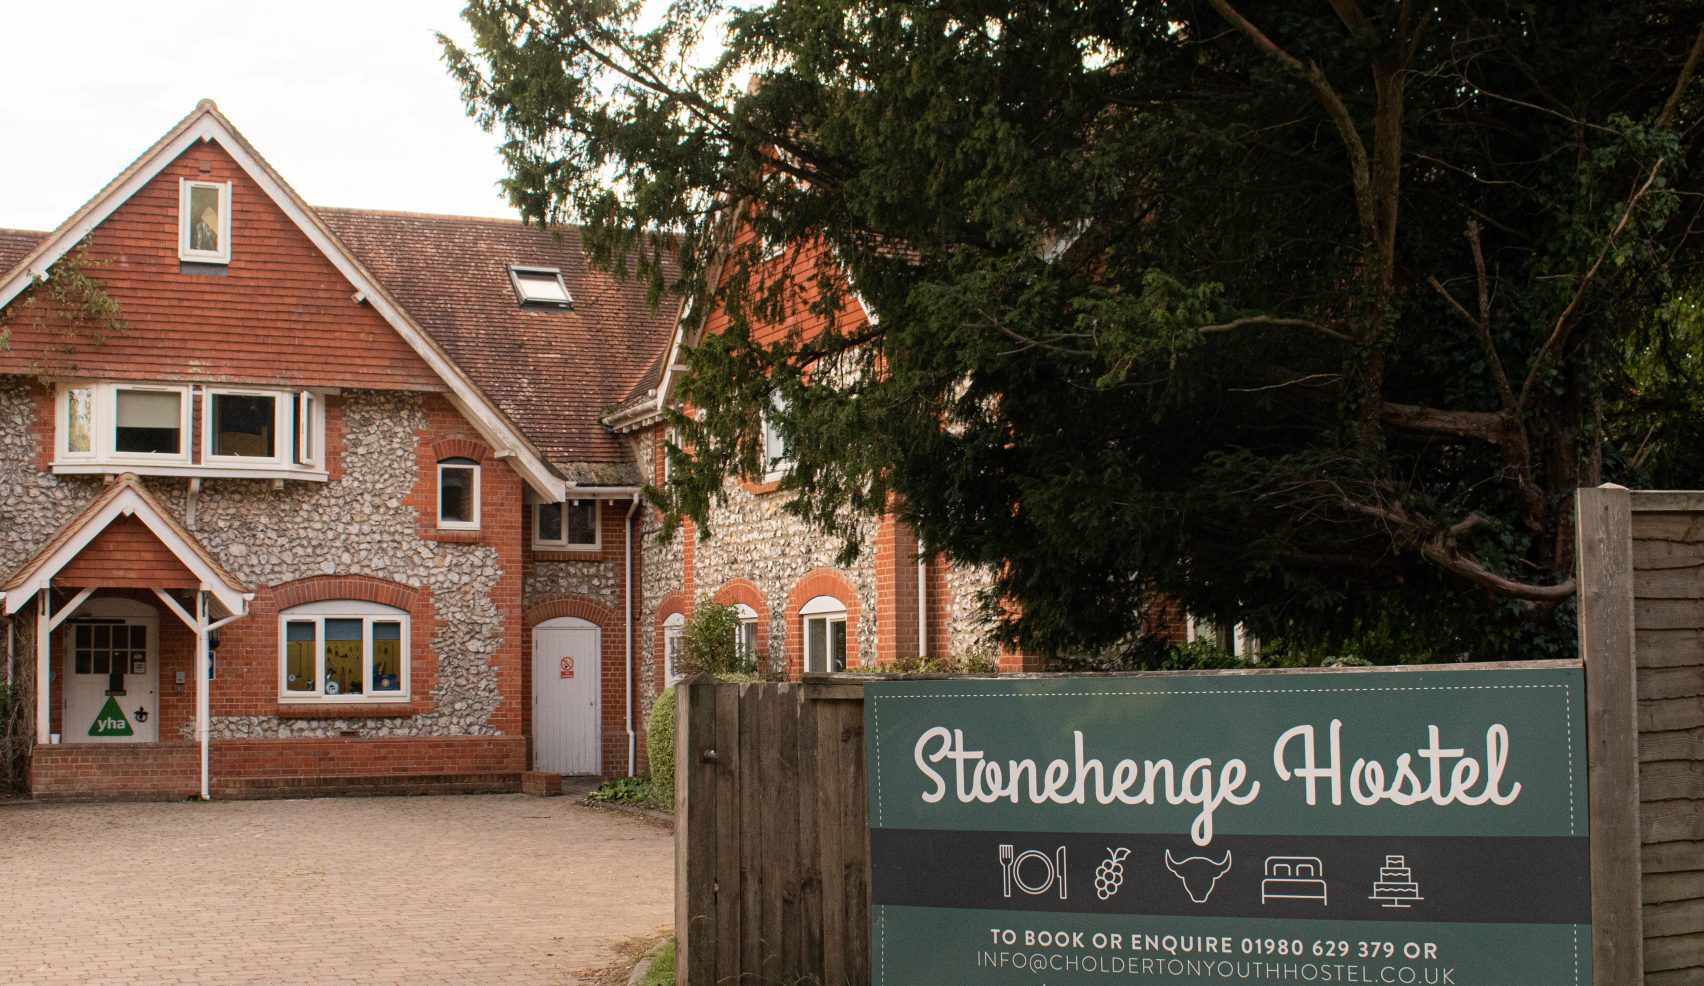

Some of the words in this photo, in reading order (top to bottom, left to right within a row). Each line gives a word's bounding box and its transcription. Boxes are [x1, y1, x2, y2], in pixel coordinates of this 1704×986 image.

[98, 717, 125, 732] yha
[913, 726, 1260, 847] Stonehenge
[1273, 718, 1522, 806] Hostel
[990, 928, 1017, 945] TO
[1024, 930, 1085, 948] BOOK
[1092, 932, 1123, 950] OR
[1131, 934, 1233, 955] ENQUIRE
[1241, 937, 1304, 956] 01980
[1312, 940, 1350, 957] 629
[1358, 941, 1395, 958] 379
[1403, 942, 1437, 960] OR
[977, 951, 1455, 985] INFO@CHOLDERTONYOUTHHOSTEL.CO.UK
